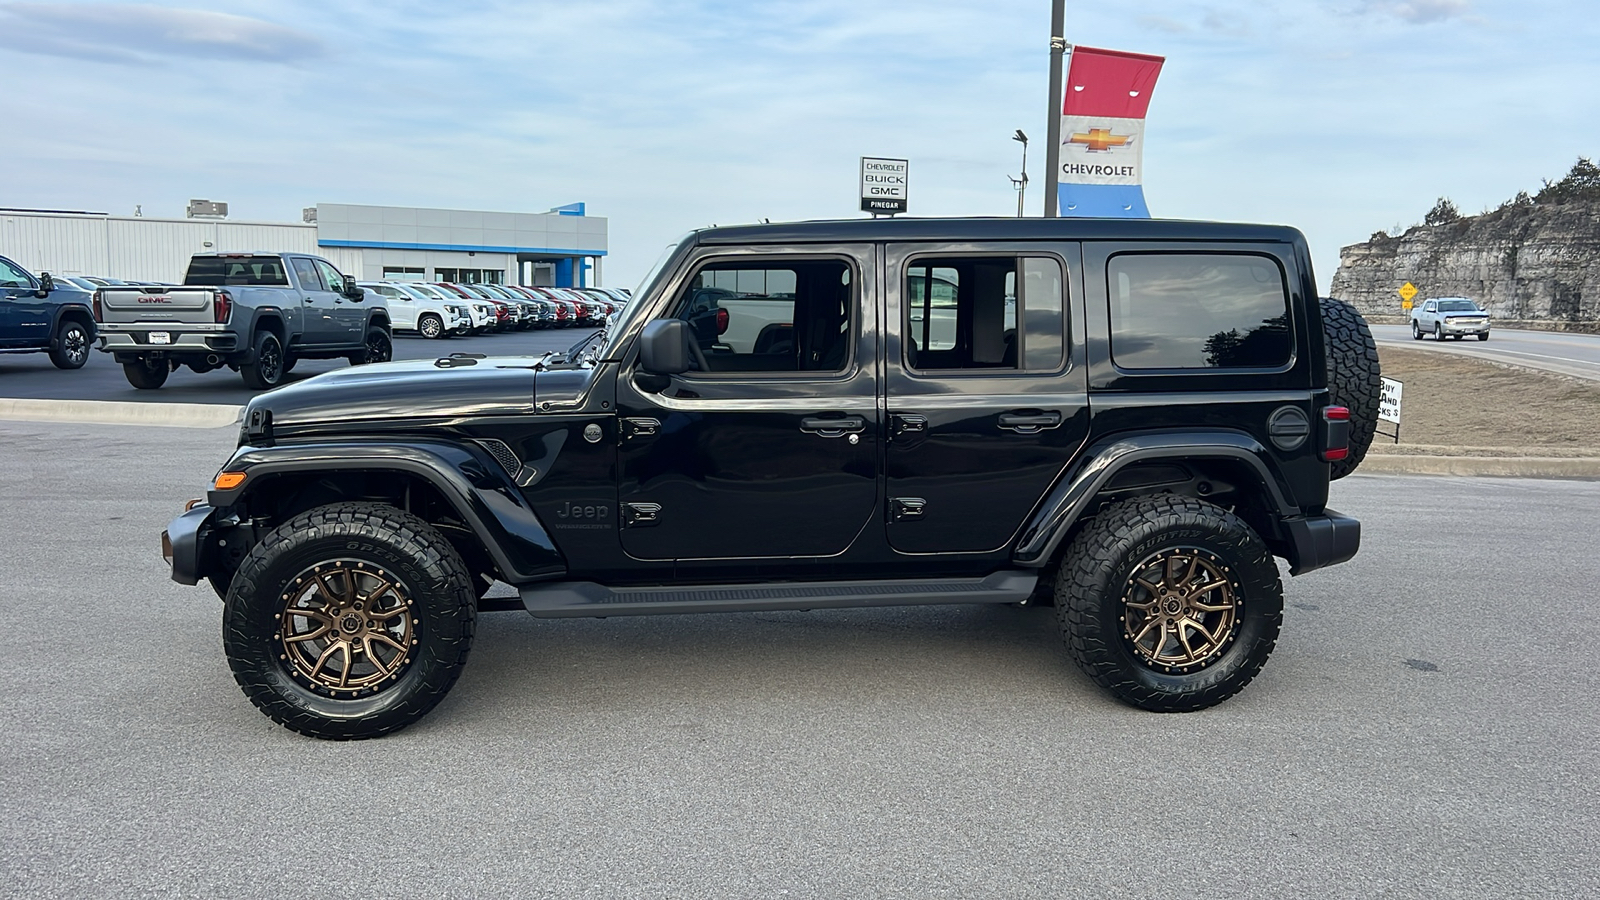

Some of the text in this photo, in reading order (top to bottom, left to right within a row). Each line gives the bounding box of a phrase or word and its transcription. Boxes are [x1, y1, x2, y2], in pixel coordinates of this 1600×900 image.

[866, 163, 905, 172] CHEVROLET
[1062, 163, 1135, 177] CHEVROLET
[865, 174, 905, 184] BUICK
[870, 187, 899, 196] GMC
[870, 201, 899, 209] PINEGAR
[137, 296, 172, 304] GMC
[1380, 379, 1395, 393] BUY
[1380, 393, 1398, 407] AND
[556, 501, 609, 521] Jeep
[345, 541, 400, 563] OPEN
[1127, 529, 1203, 563] COUNTRY
